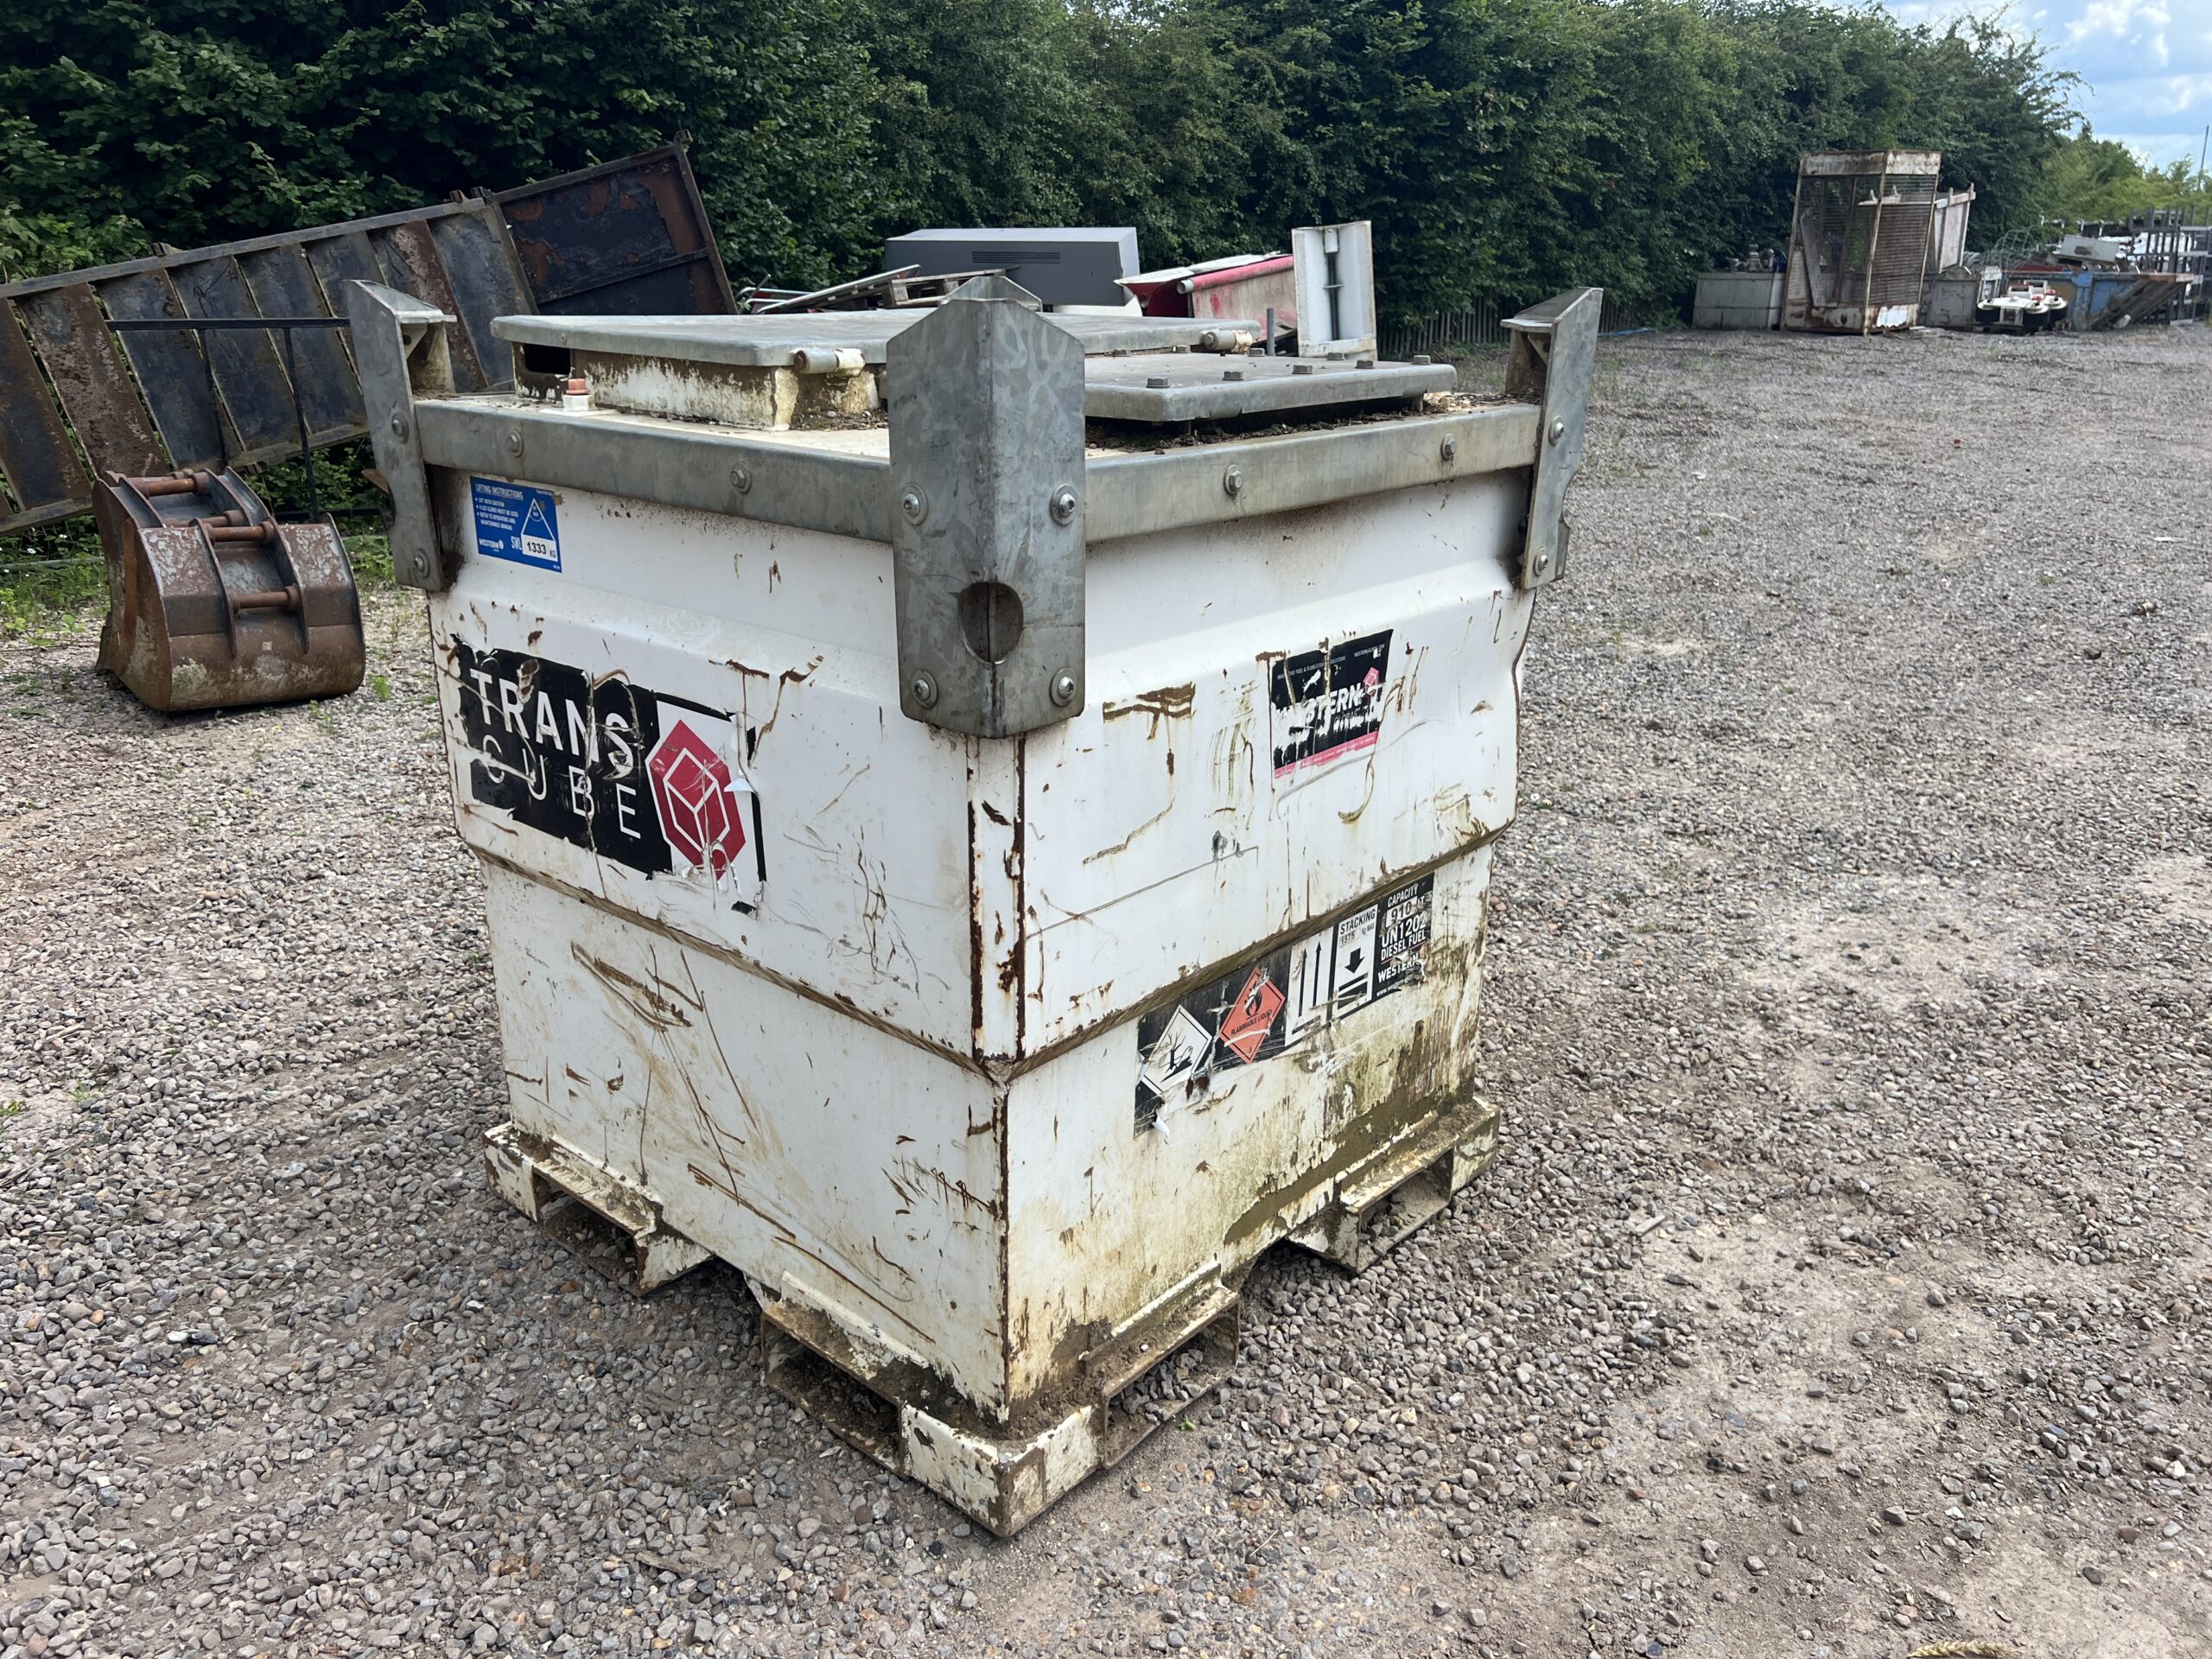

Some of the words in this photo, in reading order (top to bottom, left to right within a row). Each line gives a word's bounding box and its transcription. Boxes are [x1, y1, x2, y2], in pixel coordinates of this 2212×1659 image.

[475, 483, 492, 493] LIFTING
[492, 486, 524, 499] INSTRUCTIONS
[479, 538, 499, 550] WESTERN
[511, 536, 522, 550] SWL
[527, 542, 546, 555] 1333
[470, 668, 634, 779] TRANS
[482, 734, 641, 839] CUBE
[1388, 883, 1419, 908] CAPACITY
[1340, 908, 1376, 935] STACKING
[1391, 900, 1412, 922] 910
[1340, 931, 1355, 945] 1575
[1382, 911, 1427, 949] UN1202
[1381, 938, 1407, 961] DIESEL
[1408, 929, 1427, 947] FUEL
[1378, 952, 1419, 983] WESTERN
[1230, 1017, 1258, 1036] FLAMMABLE
